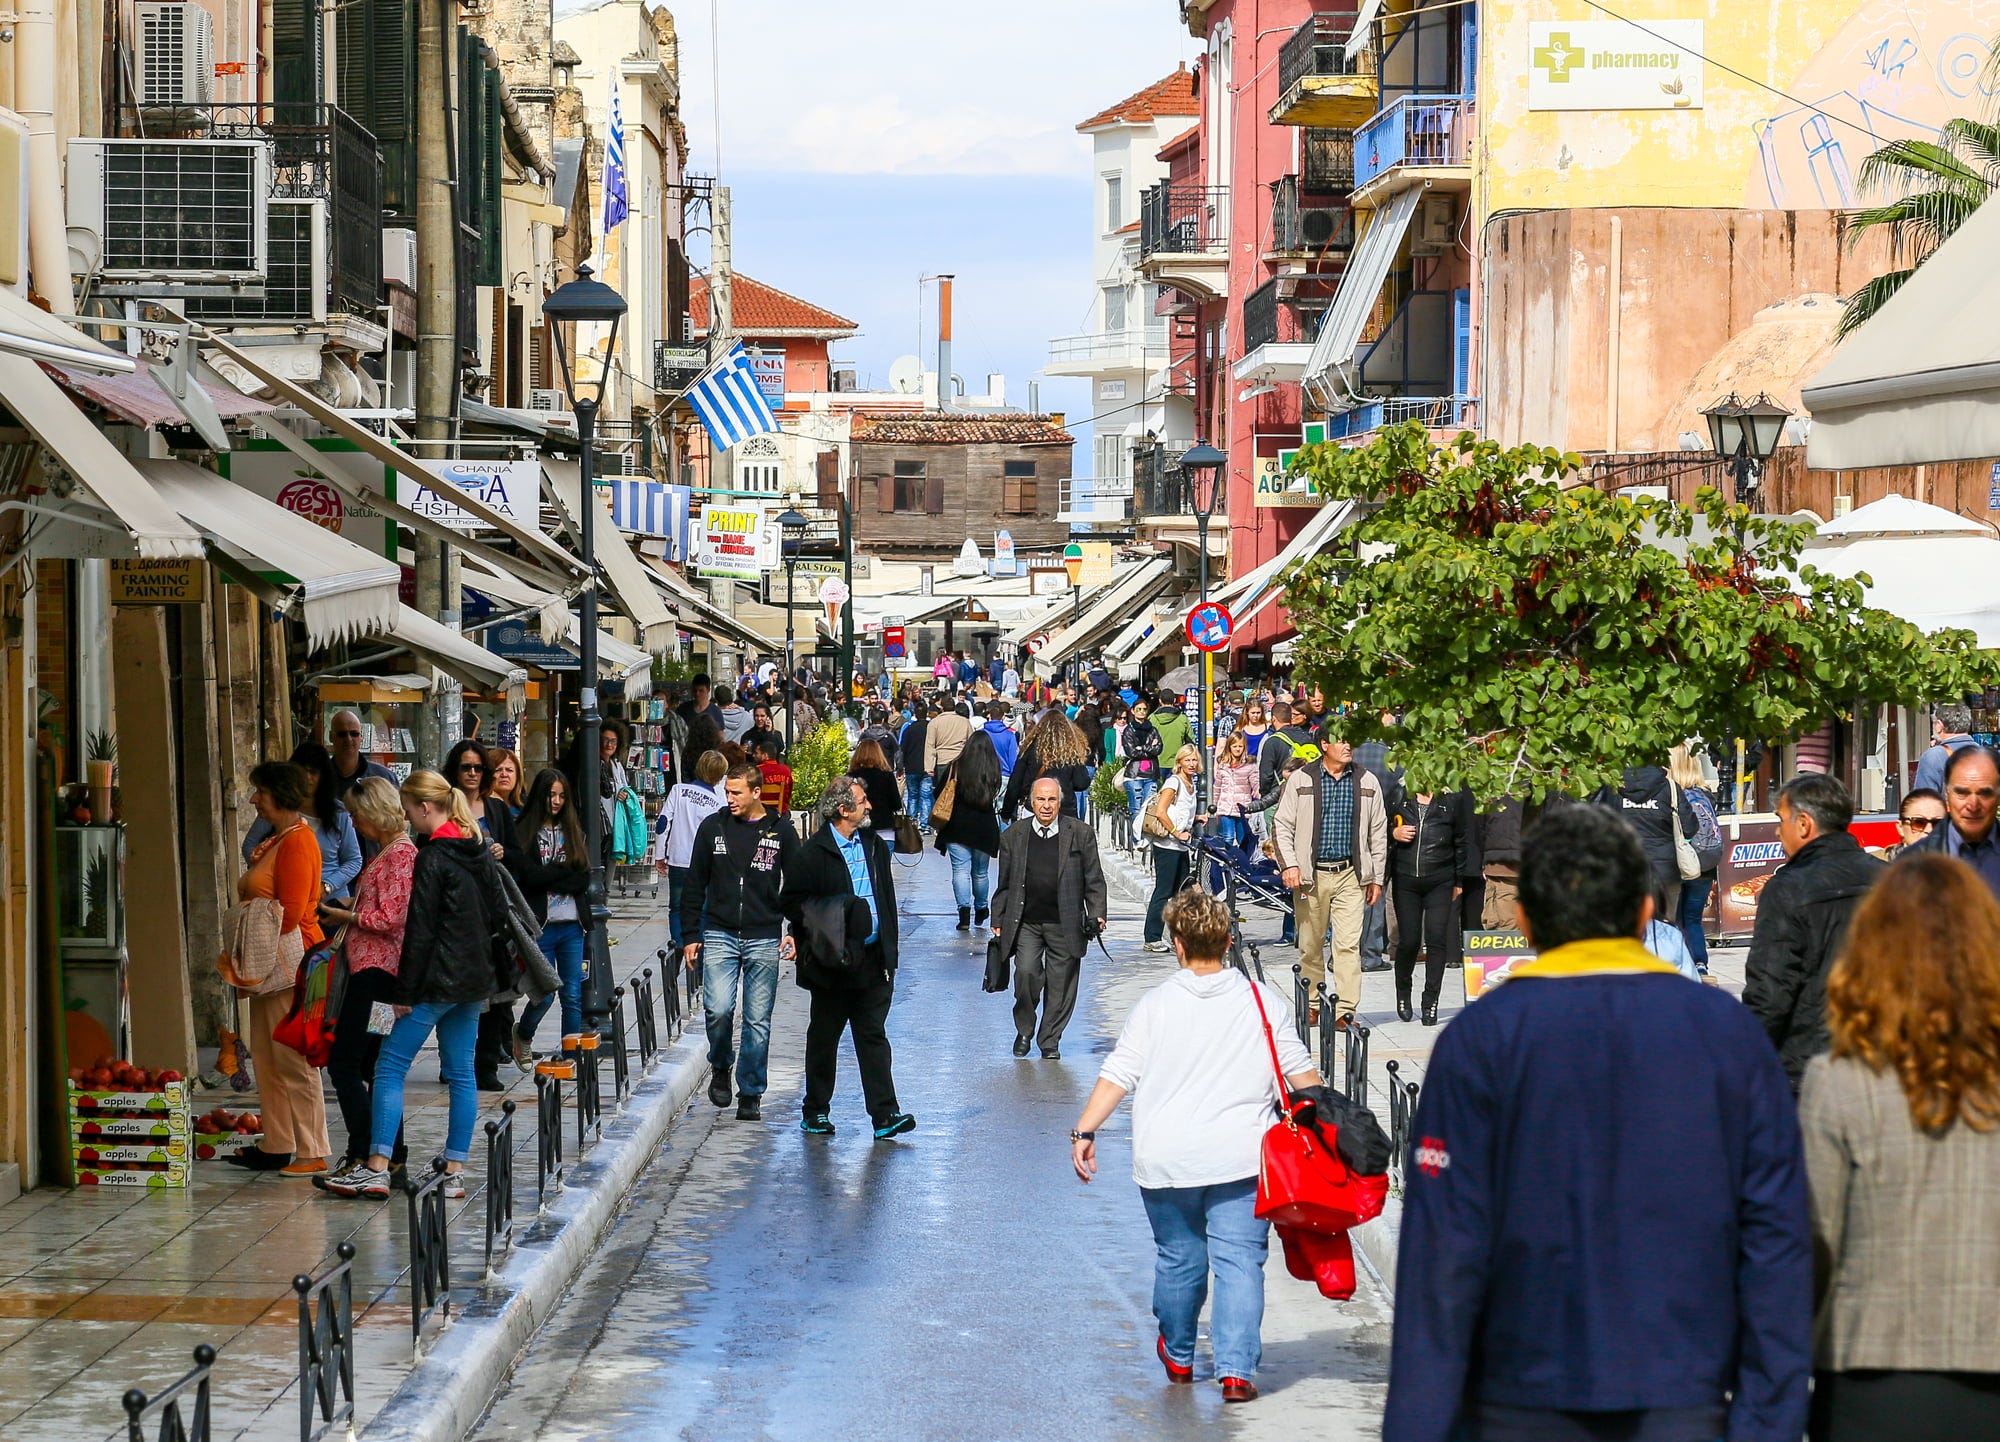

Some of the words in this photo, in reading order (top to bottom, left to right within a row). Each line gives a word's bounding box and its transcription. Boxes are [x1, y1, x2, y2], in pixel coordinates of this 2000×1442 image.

[1592, 50, 1680, 69] pharmacy
[452, 465, 513, 474] CHANIA
[343, 506, 384, 518] Natura
[411, 502, 460, 516] FISH
[707, 510, 758, 534] PRINT
[813, 563, 842, 574] STORE
[121, 574, 190, 586] FRAMING
[126, 586, 186, 598] PAINTIG
[1732, 843, 1786, 861] SNICKER
[1469, 935, 1529, 949] BREAK
[104, 1096, 137, 1106] apples
[107, 1123, 141, 1133] apples
[217, 1138, 243, 1147] apples
[105, 1149, 138, 1159] apples
[104, 1175, 138, 1184] apples
